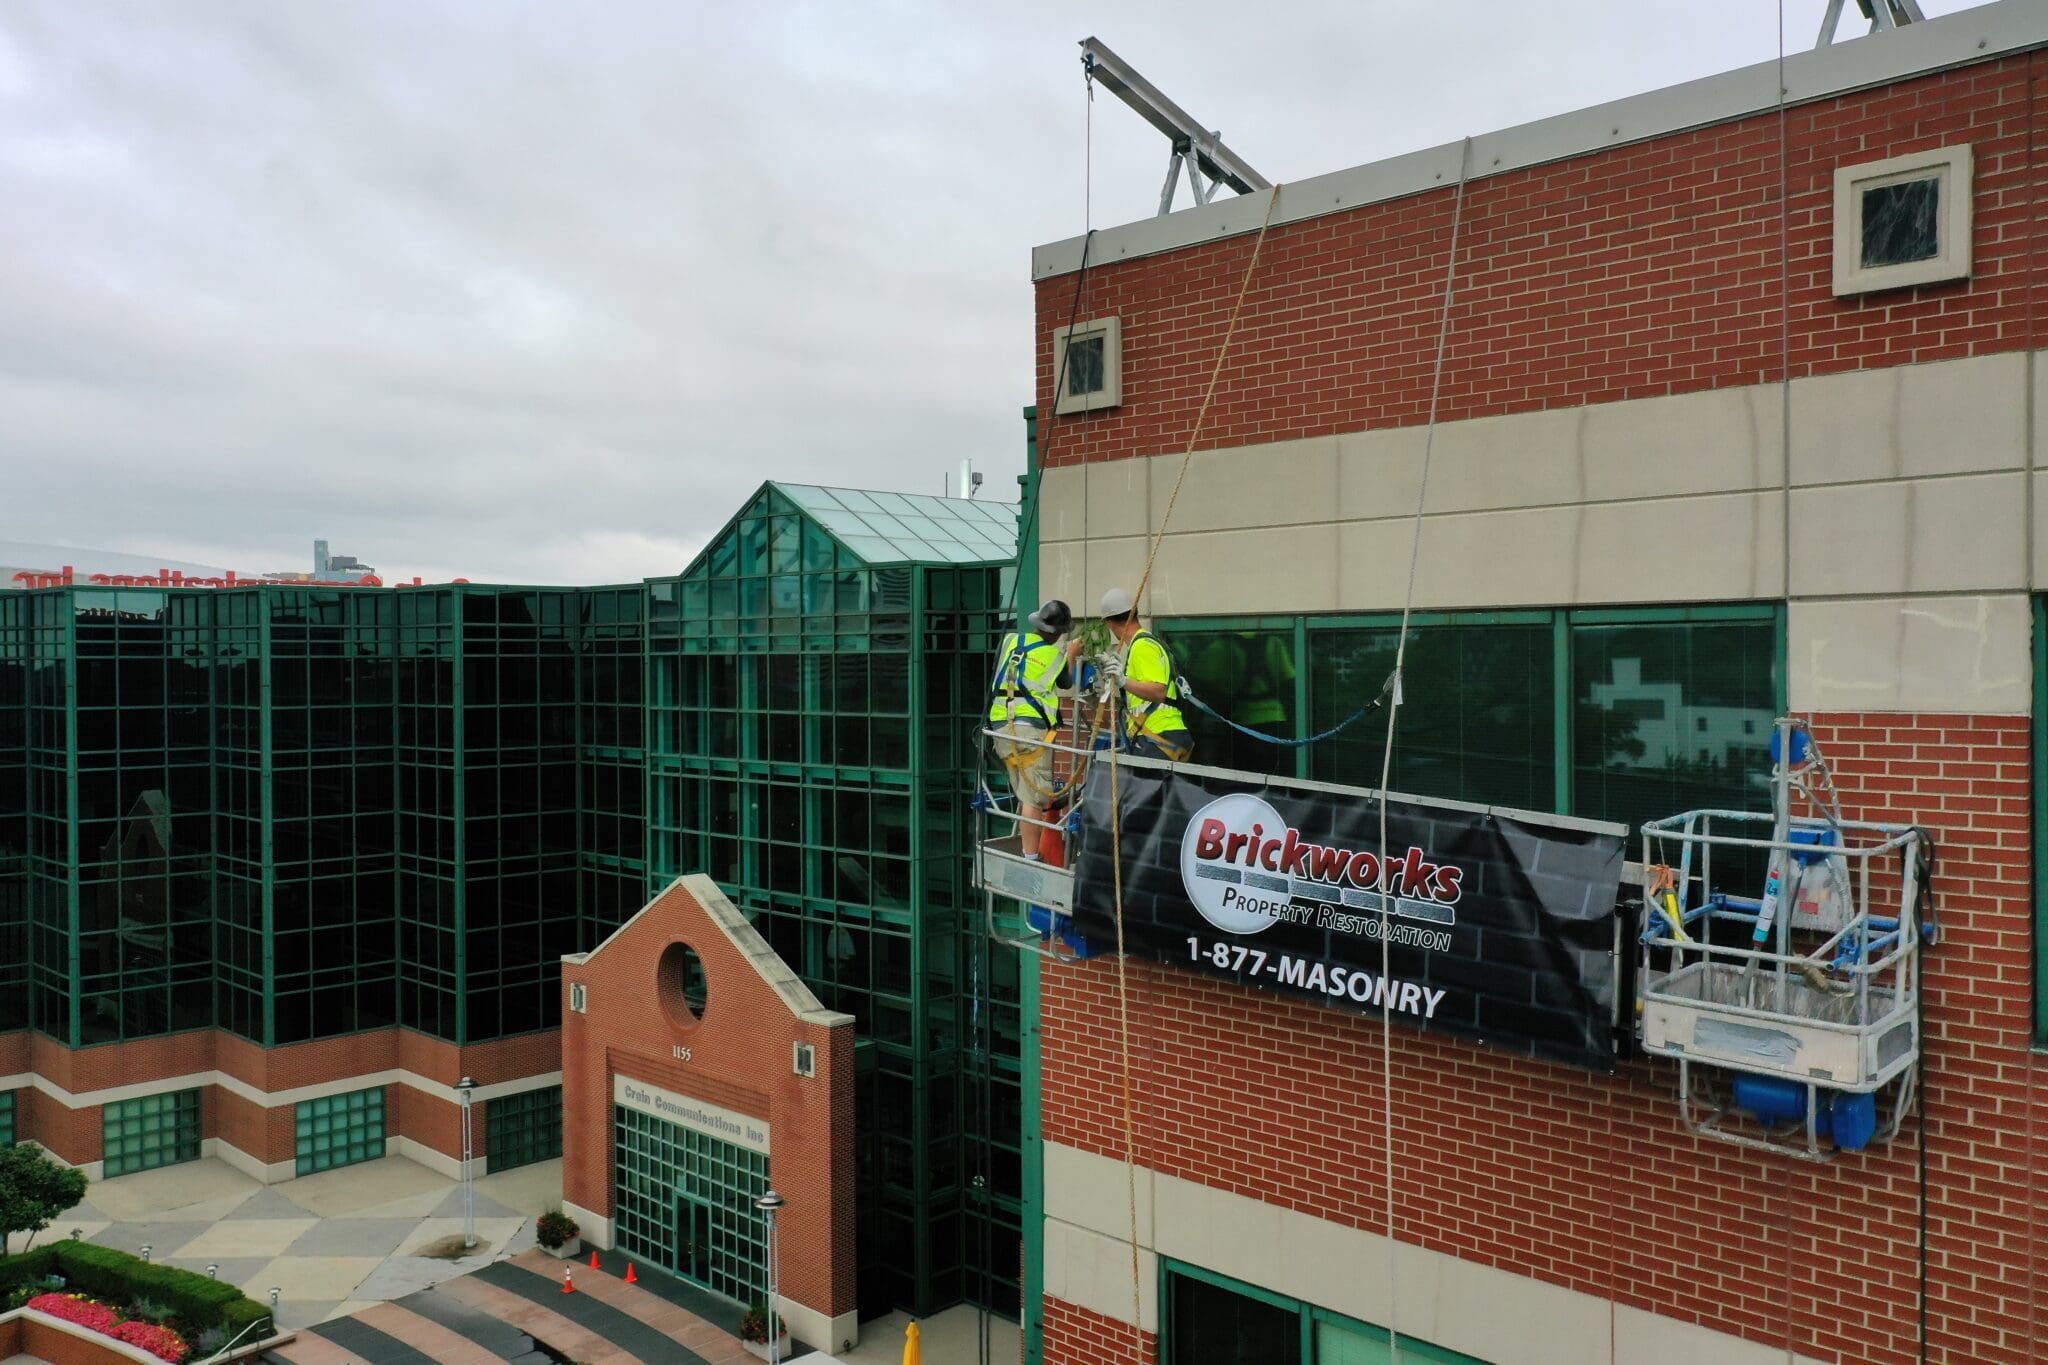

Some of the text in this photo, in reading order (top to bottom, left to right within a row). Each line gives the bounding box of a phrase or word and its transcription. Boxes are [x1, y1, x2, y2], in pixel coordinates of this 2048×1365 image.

[1196, 818, 1462, 904] Brickworks
[1222, 887, 1452, 952] PROPERTY RESTORATION
[1187, 937, 1446, 1018] 1-877-MASONRY
[673, 1045, 691, 1061] 1155
[624, 1085, 764, 1144] Crain Communications Inc
